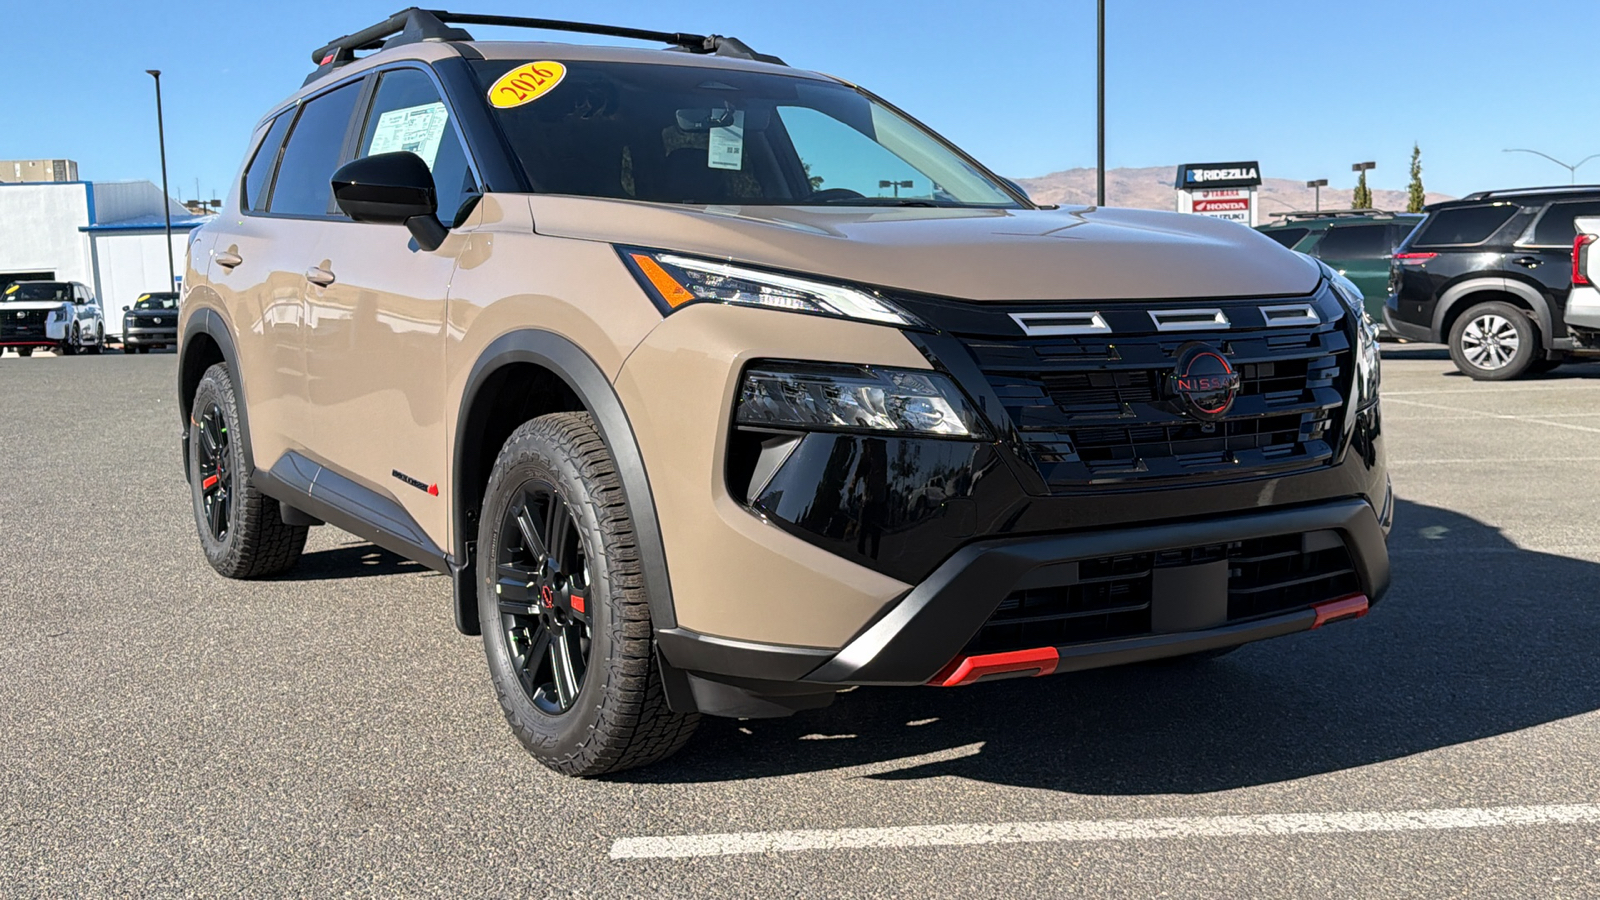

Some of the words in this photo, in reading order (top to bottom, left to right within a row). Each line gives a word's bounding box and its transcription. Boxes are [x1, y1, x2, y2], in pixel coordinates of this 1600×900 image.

[500, 65, 554, 101] 2026
[1203, 168, 1257, 180] RIDEZILLA
[1206, 202, 1246, 210] HONDA
[1178, 377, 1239, 389] NISSAN
